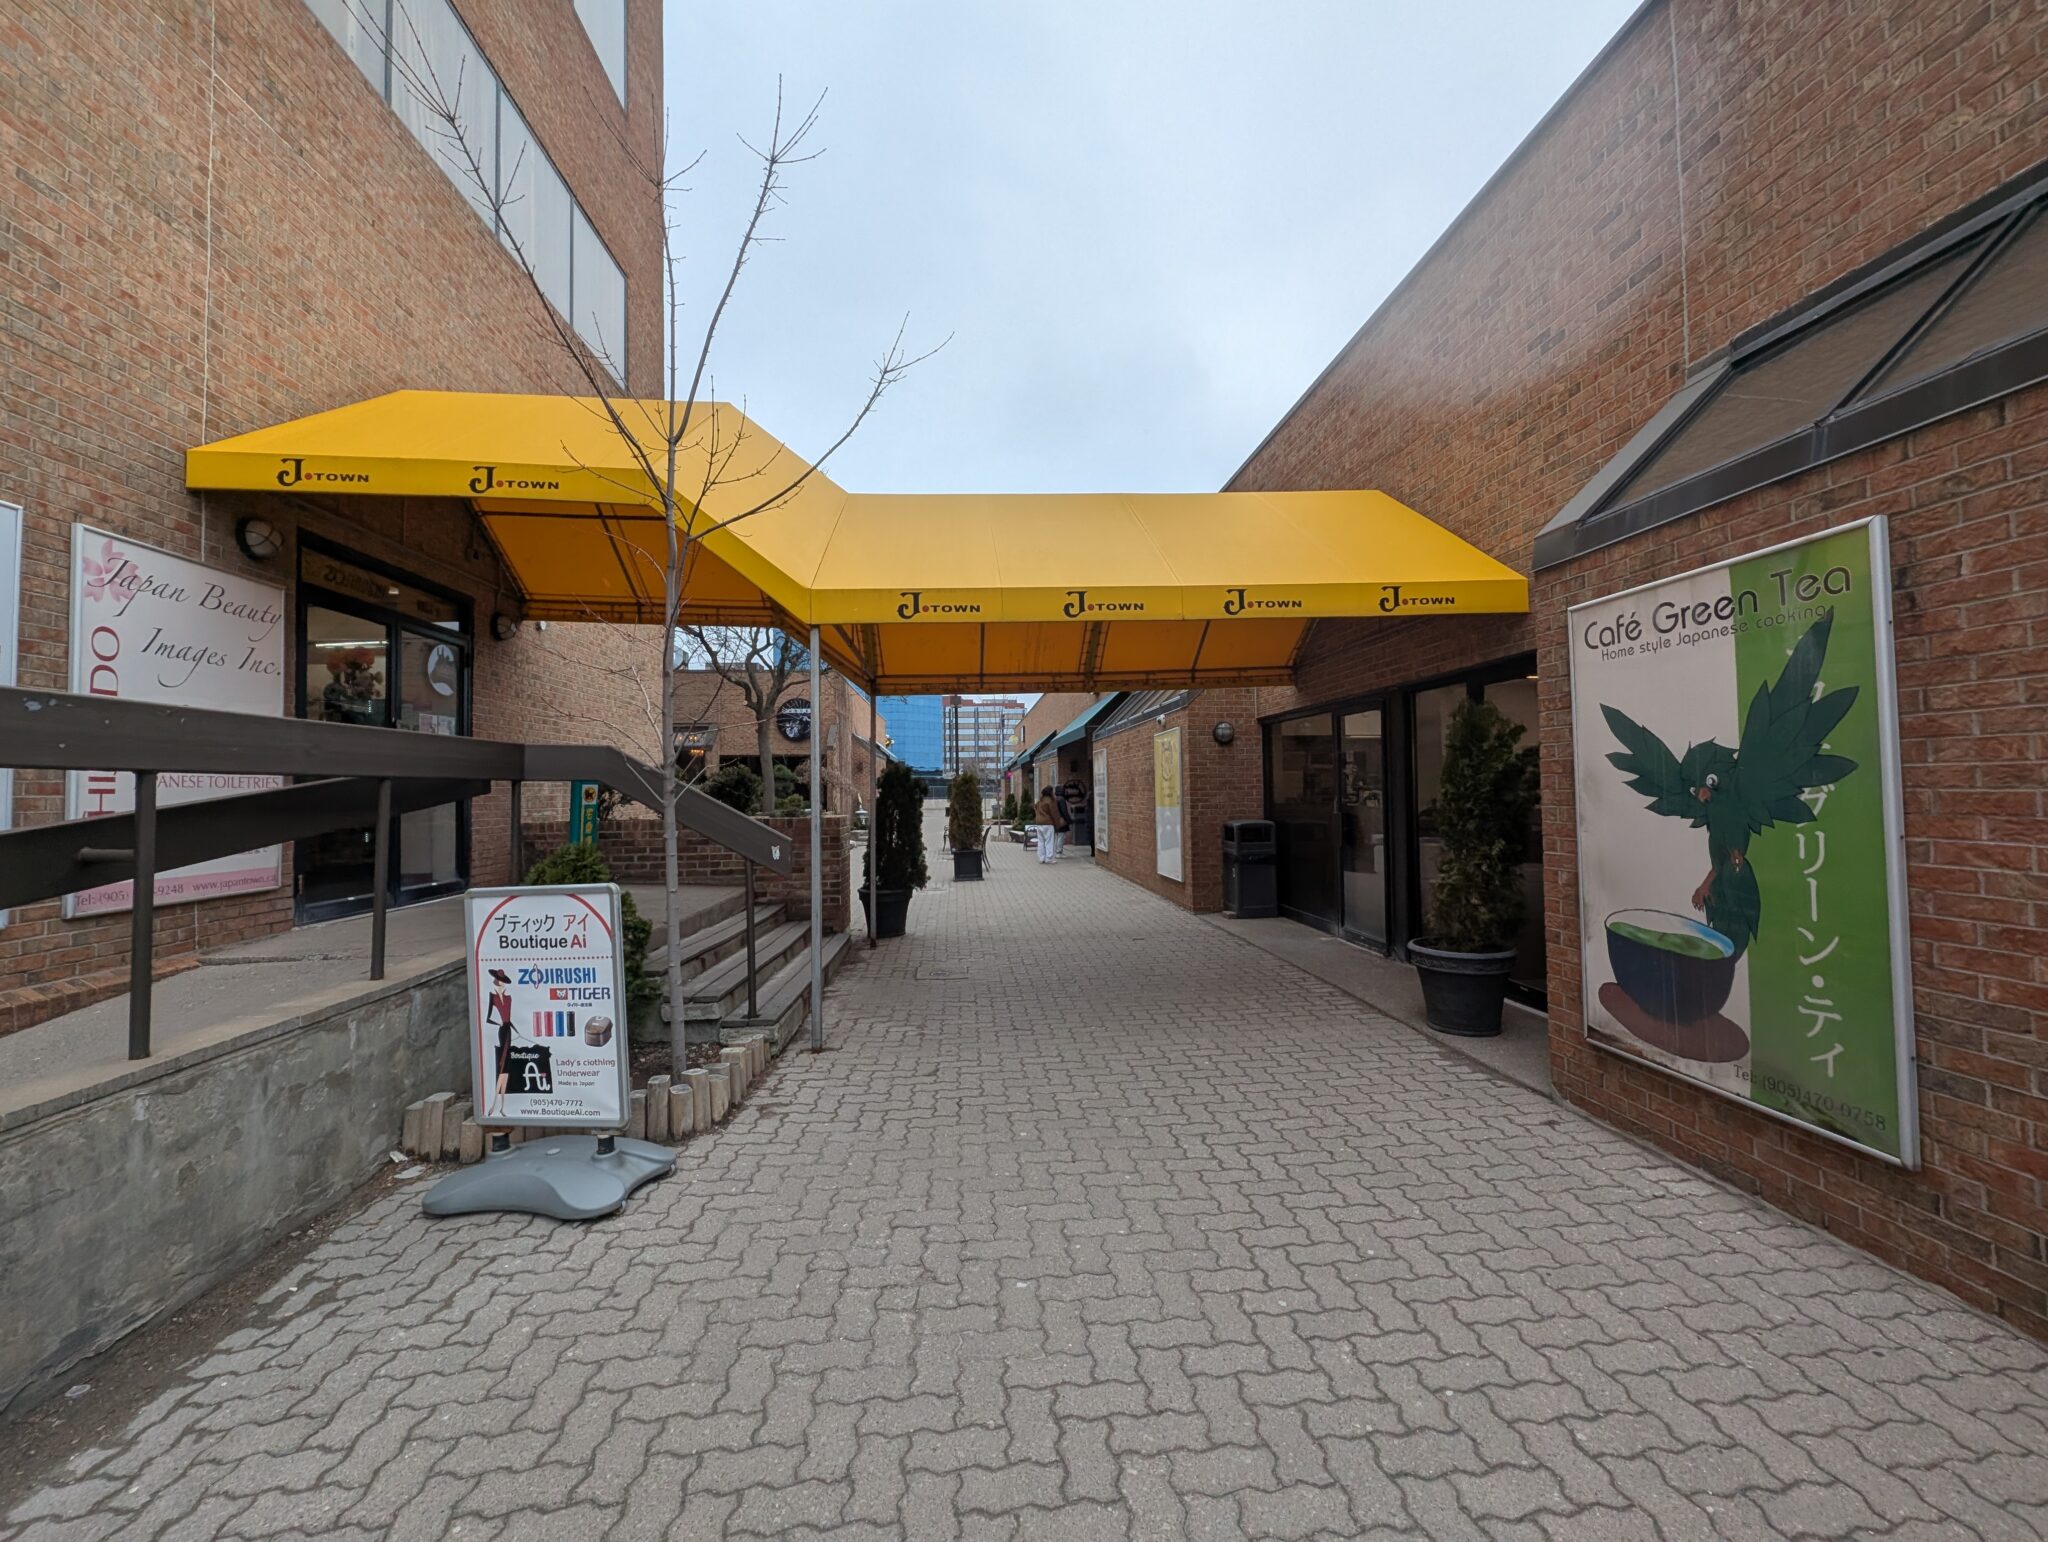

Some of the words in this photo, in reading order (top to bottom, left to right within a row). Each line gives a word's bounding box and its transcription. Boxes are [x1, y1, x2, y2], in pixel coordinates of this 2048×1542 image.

[87, 556, 190, 617] Japan
[198, 582, 282, 642] Beauty
[1583, 612, 1643, 650] Café
[1652, 589, 1758, 635] Green
[1770, 566, 1852, 607] Tea
[1601, 644, 1635, 662] Home
[1639, 635, 1672, 654] style
[1676, 619, 1749, 649] Japanese
[1756, 604, 1828, 629] cooking
[139, 627, 228, 688] Images
[237, 647, 282, 676] Inc.
[208, 775, 279, 789] TOILETRIES
[494, 914, 556, 934] ブティック
[563, 913, 589, 932] アイ
[499, 935, 568, 950] Boutique
[570, 934, 587, 949] Ai
[518, 965, 597, 987] ZOJIRUSHI
[568, 987, 611, 1000] TIGER
[557, 1069, 601, 1078] Underwear
[530, 1098, 584, 1107] (905)470-7772
[520, 1107, 601, 1118] www.BoutiqueAi.com
